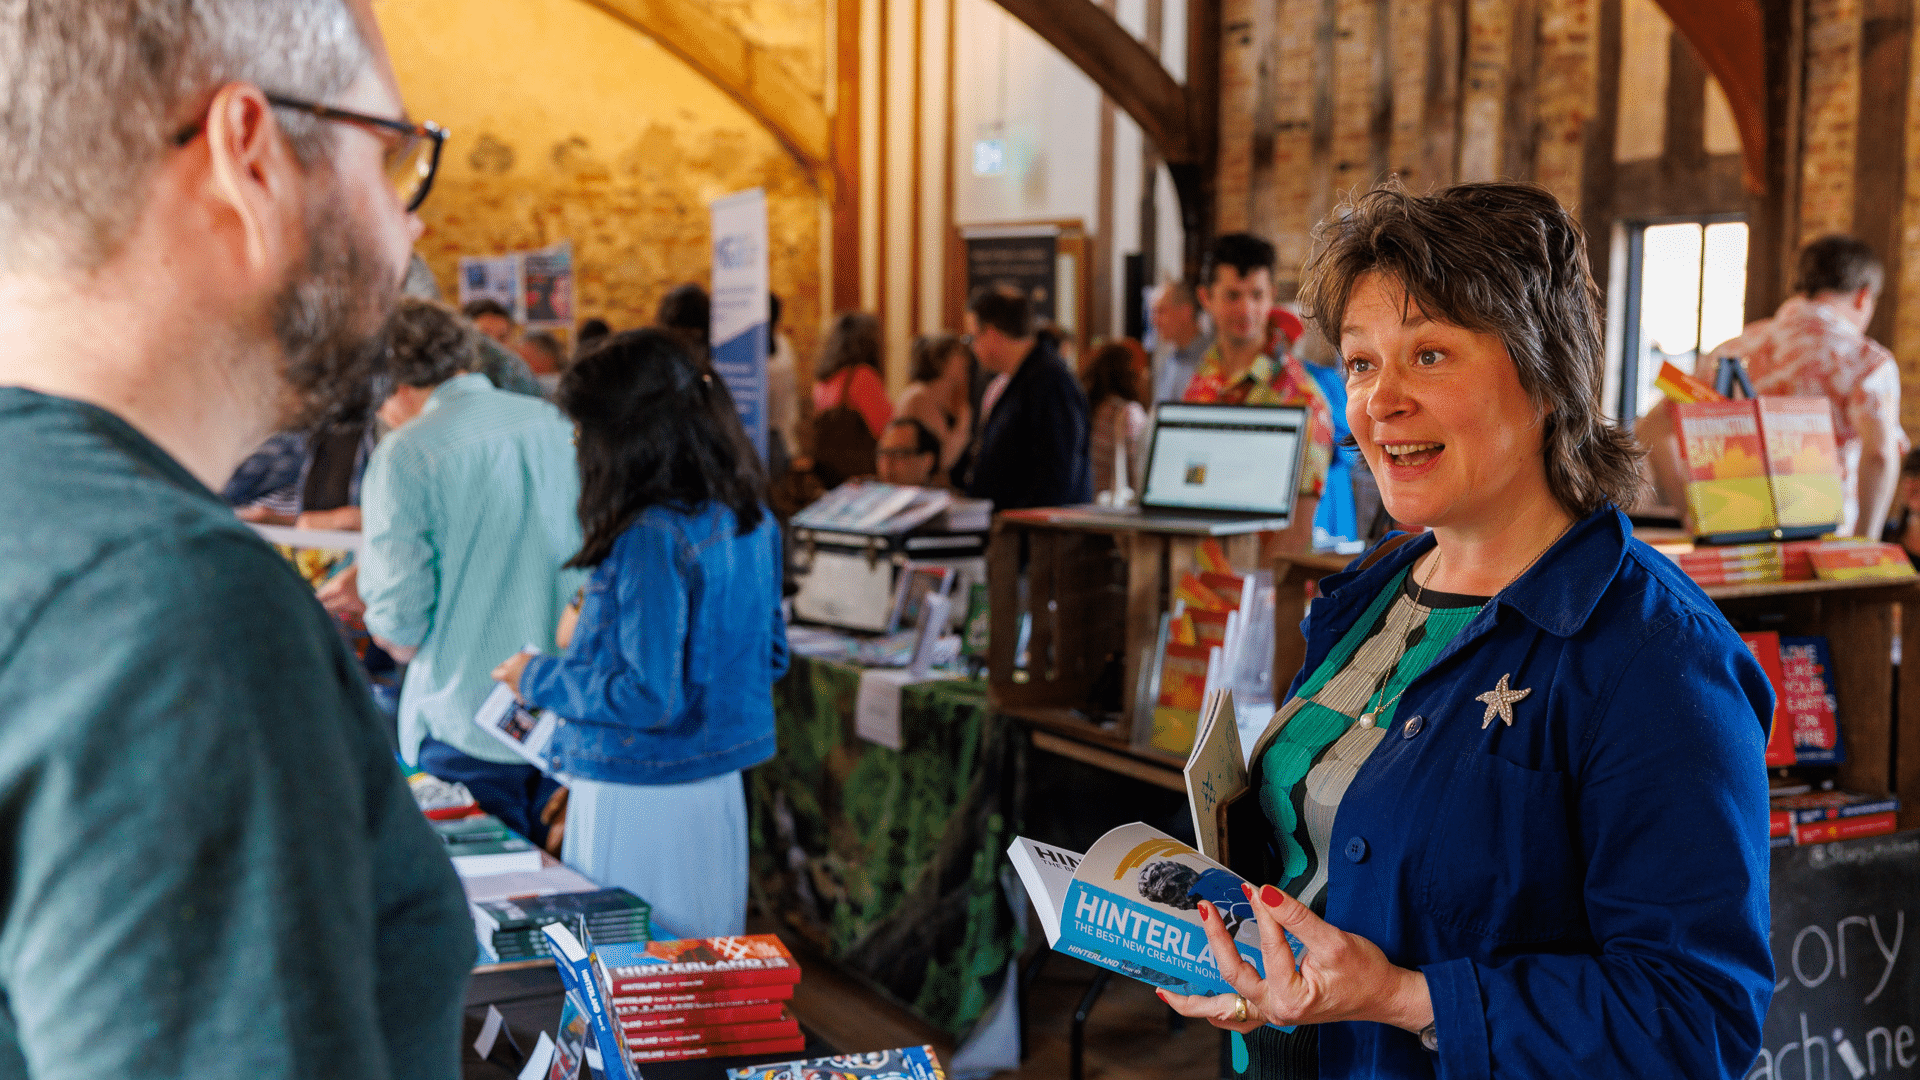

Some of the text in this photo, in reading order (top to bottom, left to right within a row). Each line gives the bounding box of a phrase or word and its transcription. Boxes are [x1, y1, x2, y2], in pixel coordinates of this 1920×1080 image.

[1074, 920, 1094, 940] THE
[1096, 928, 1121, 945] BEST
[1122, 938, 1146, 954] NEW
[1147, 947, 1193, 972] CREATIVE
[1075, 890, 1257, 969] HINTERLA
[616, 958, 763, 977] HINTERLAND
[1067, 945, 1120, 967] HINTERLAND
[1771, 910, 1905, 1005] ory
[581, 969, 601, 1014] HINTERLAND
[1749, 1012, 1918, 1080] achine
